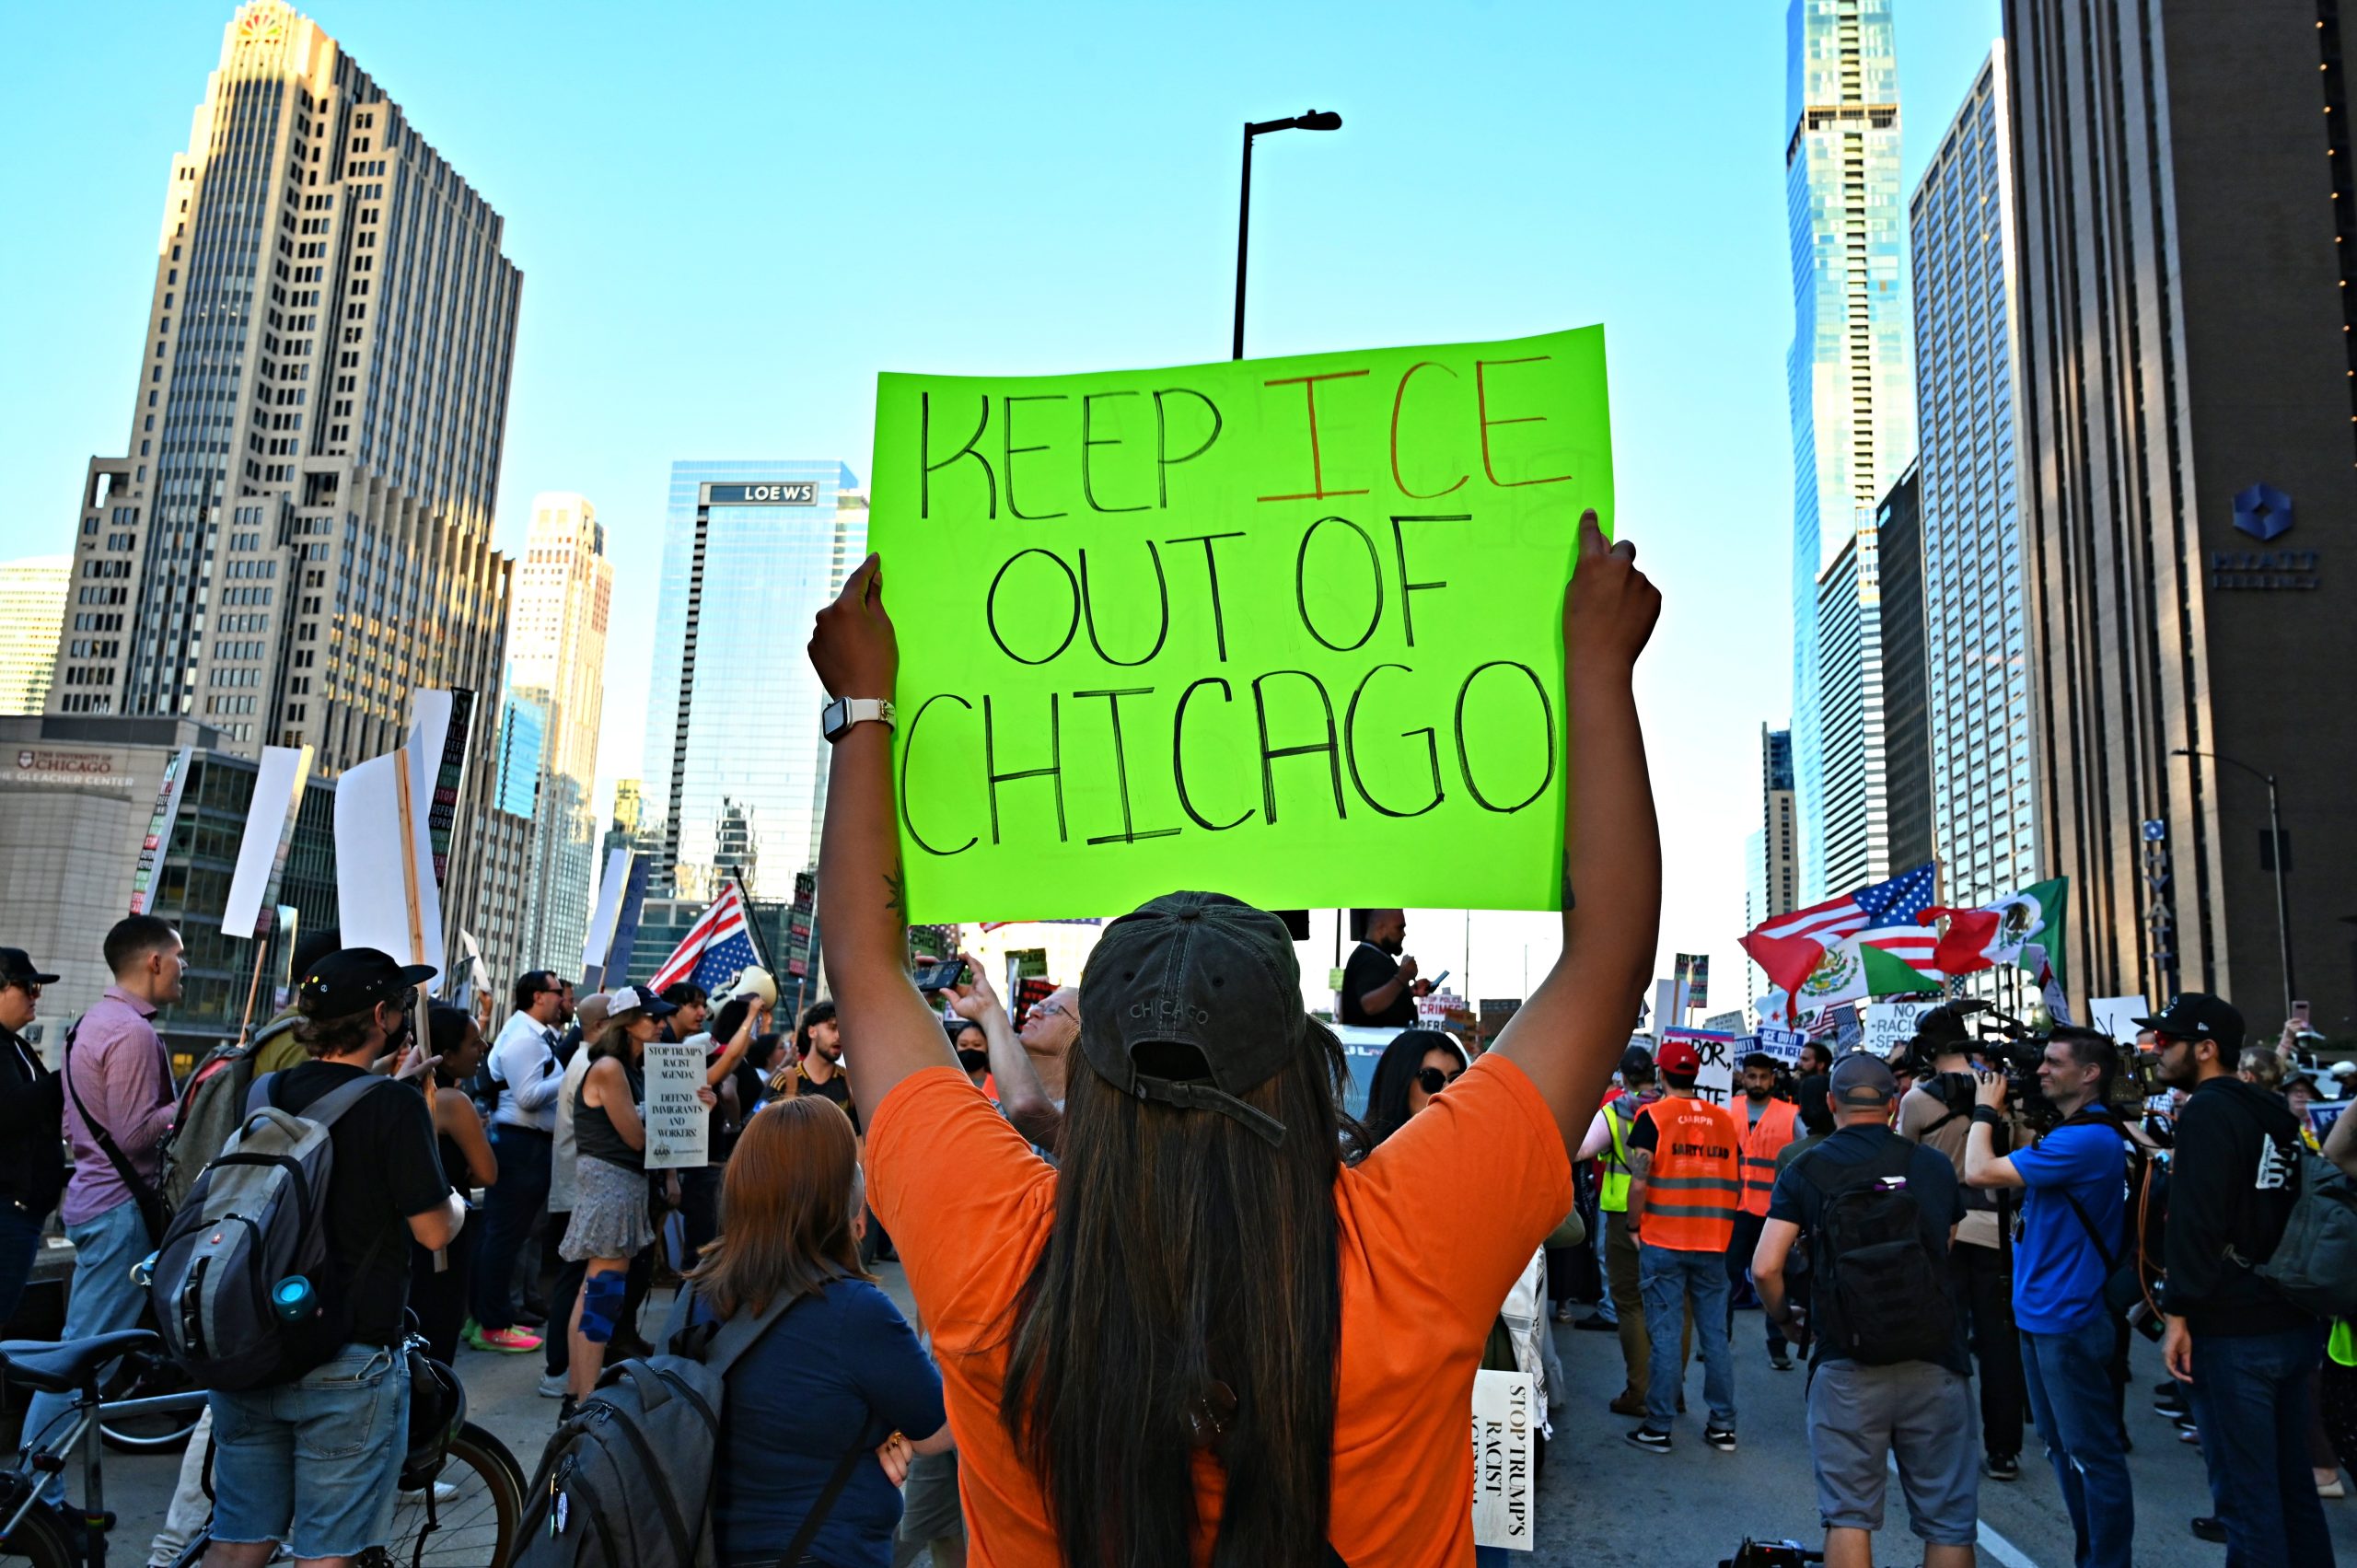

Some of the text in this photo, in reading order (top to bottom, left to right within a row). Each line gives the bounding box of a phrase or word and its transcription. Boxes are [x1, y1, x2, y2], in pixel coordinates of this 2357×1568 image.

[921, 355, 1573, 520] KEEP ICE
[744, 485, 812, 502] LOEWS
[986, 514, 1472, 667] OUT OF
[900, 659, 1557, 856] CHICAGO
[36, 759, 111, 774] CHICAGO
[17, 771, 82, 784] GLEACHER
[86, 775, 134, 787] CENTER
[432, 804, 455, 817] DEFEN
[2142, 849, 2173, 971] HYATT
[1129, 1001, 1209, 1025] CHICAGO
[1894, 1004, 1916, 1017] NO
[649, 1047, 669, 1056] STOP
[663, 1059, 690, 1067] RACIST
[660, 1093, 692, 1102] DEFEND
[652, 1105, 702, 1114] IMMIGRANTS
[669, 1117, 685, 1126] AND
[1707, 1144, 1730, 1160] LEAD
[1486, 1421, 1503, 1497] RACIST
[1508, 1384, 1527, 1537] STOP TRUMP'S
